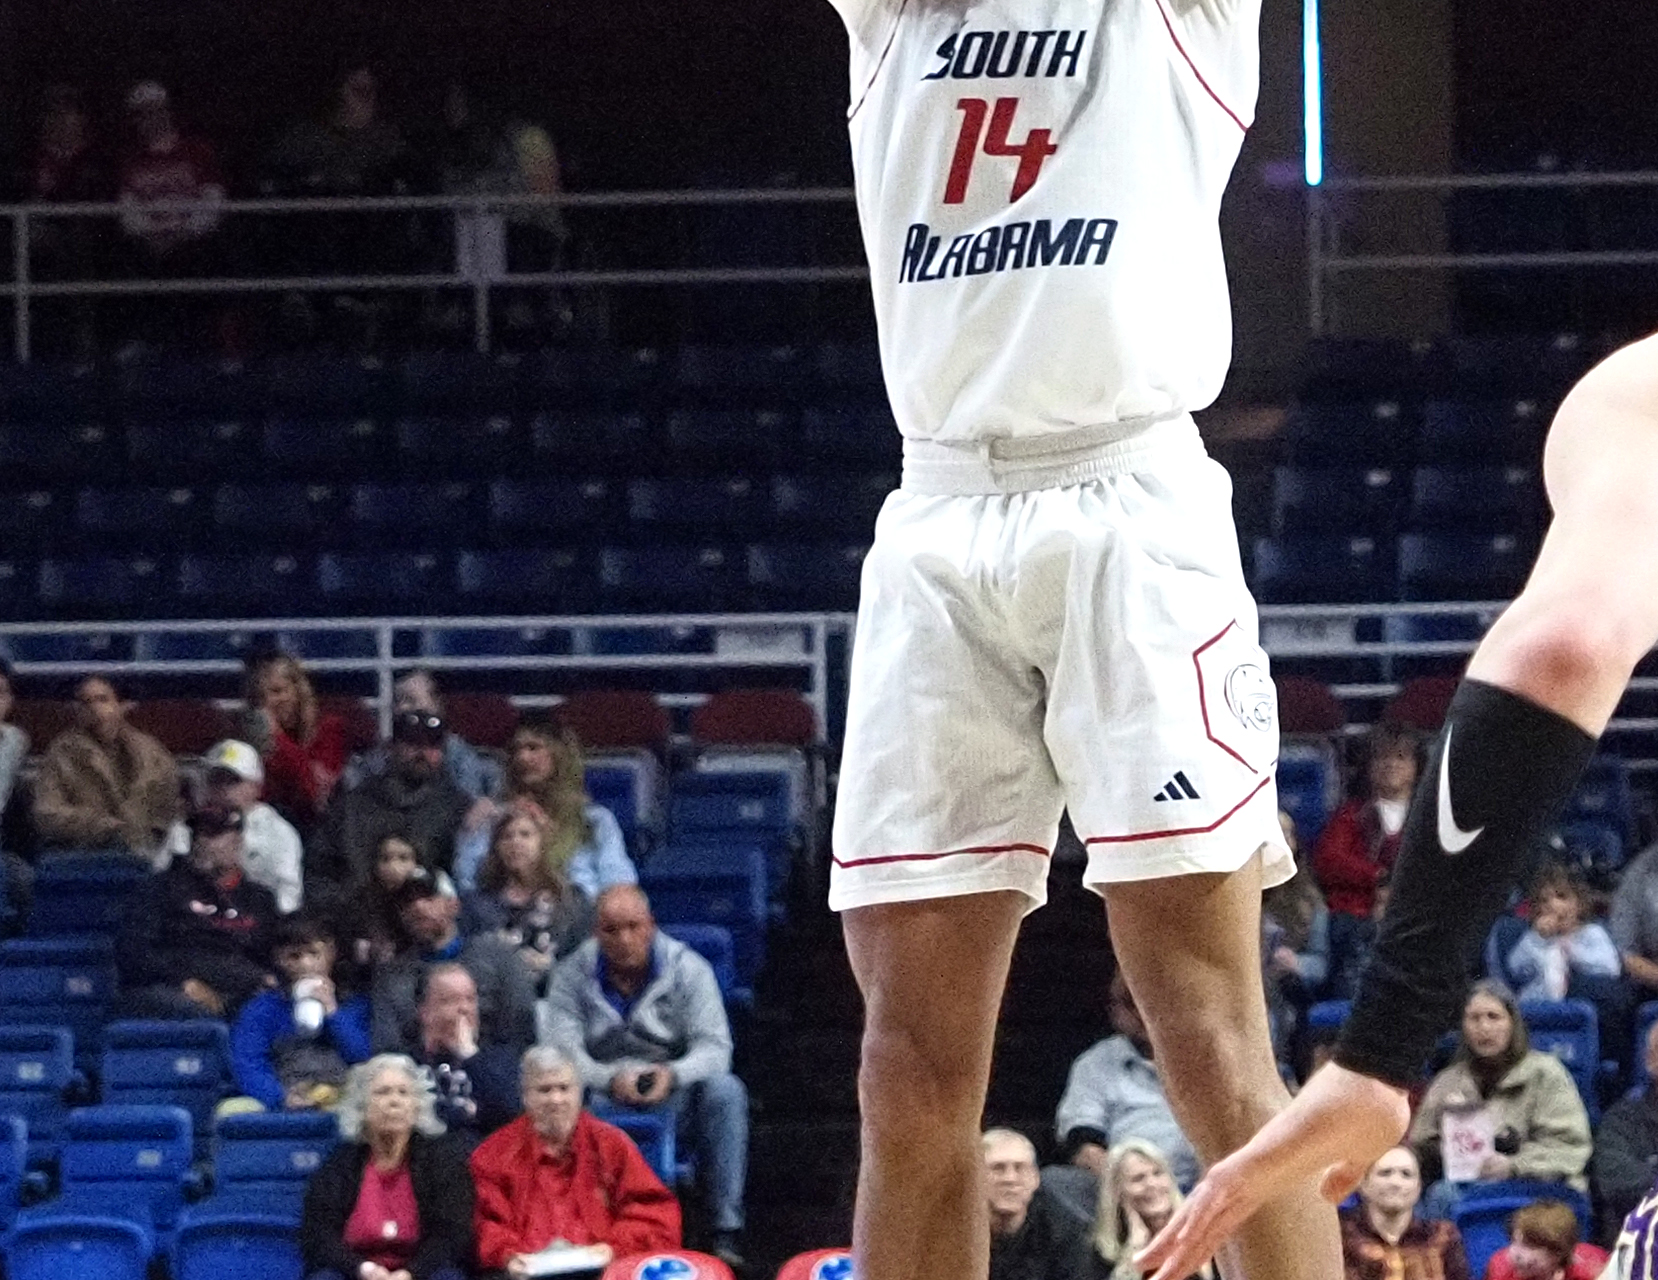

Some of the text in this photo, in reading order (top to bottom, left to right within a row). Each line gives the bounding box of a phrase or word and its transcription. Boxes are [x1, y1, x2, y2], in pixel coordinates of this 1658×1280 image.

[920, 29, 1088, 81] SOUTH
[942, 96, 1058, 205] 14
[898, 218, 1119, 284] ALABAMA
